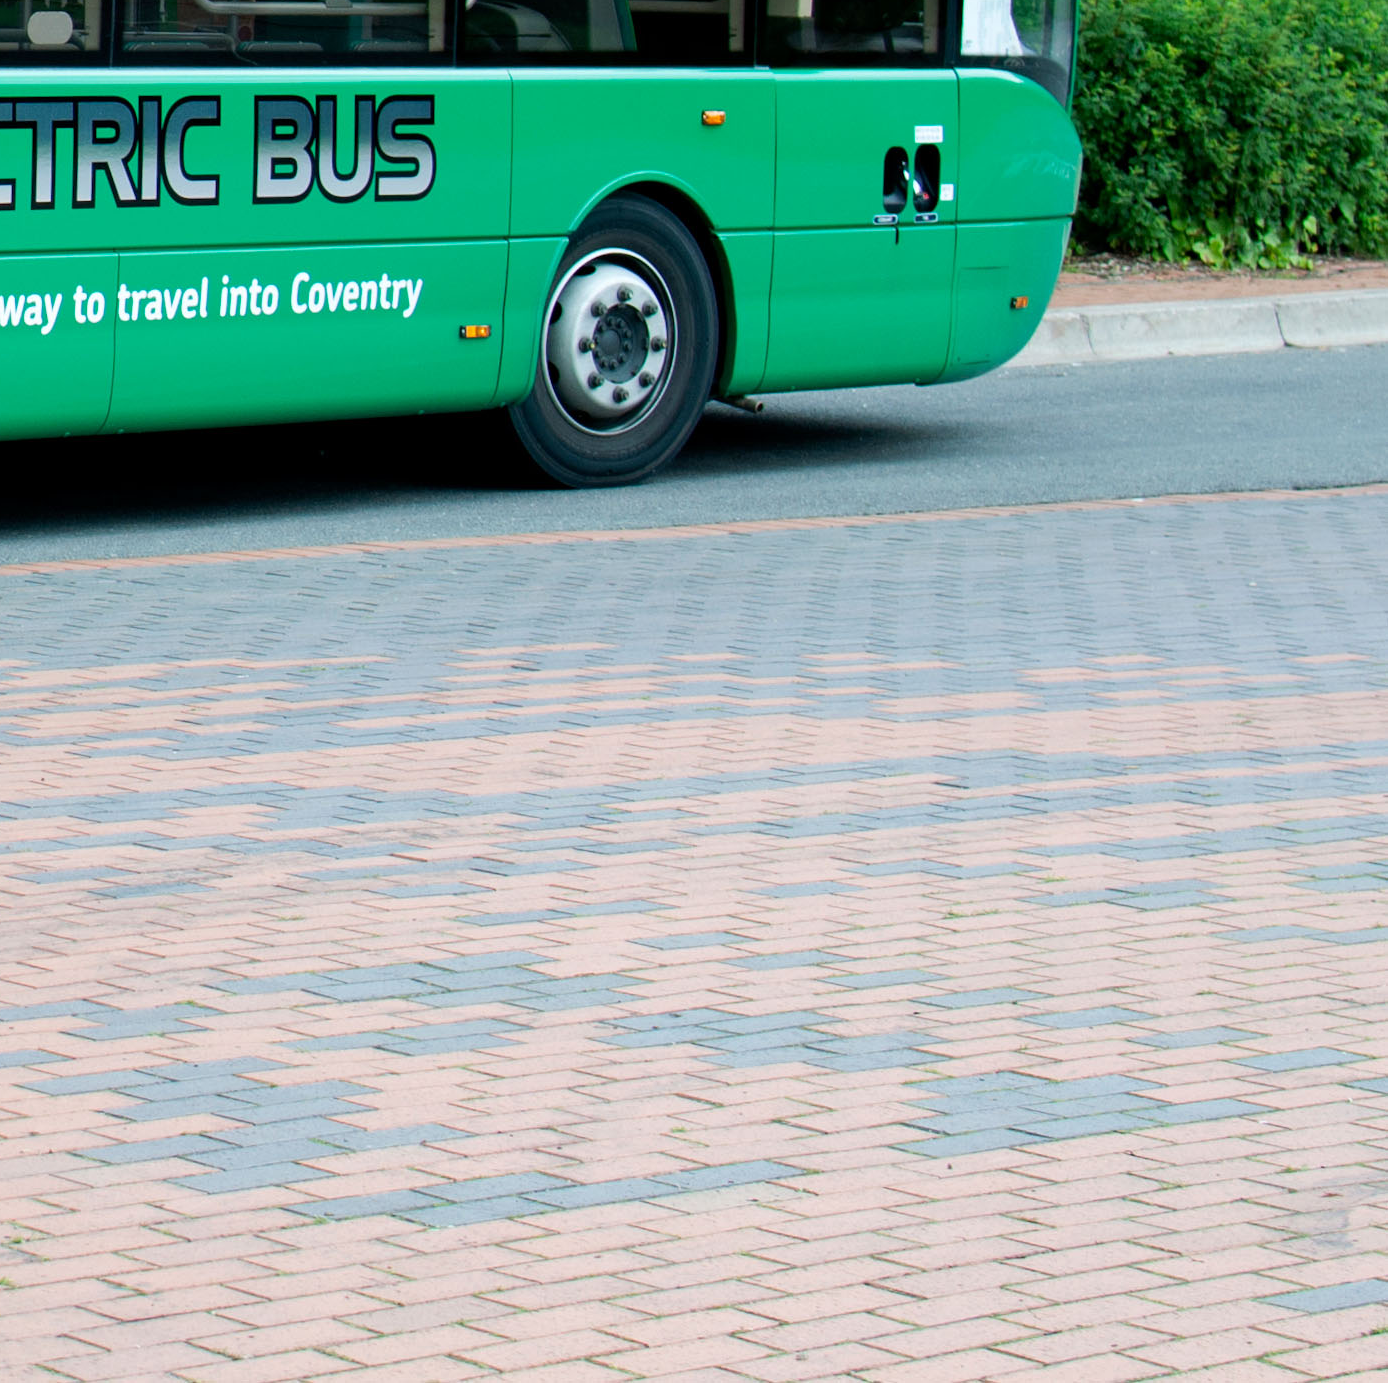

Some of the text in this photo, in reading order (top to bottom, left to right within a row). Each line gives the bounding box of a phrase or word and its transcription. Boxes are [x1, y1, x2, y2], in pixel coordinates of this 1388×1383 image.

[252, 93, 437, 205] BUS
[73, 283, 105, 324] to
[117, 276, 208, 320] travel
[219, 274, 278, 317] into
[289, 271, 424, 318] Coventry
